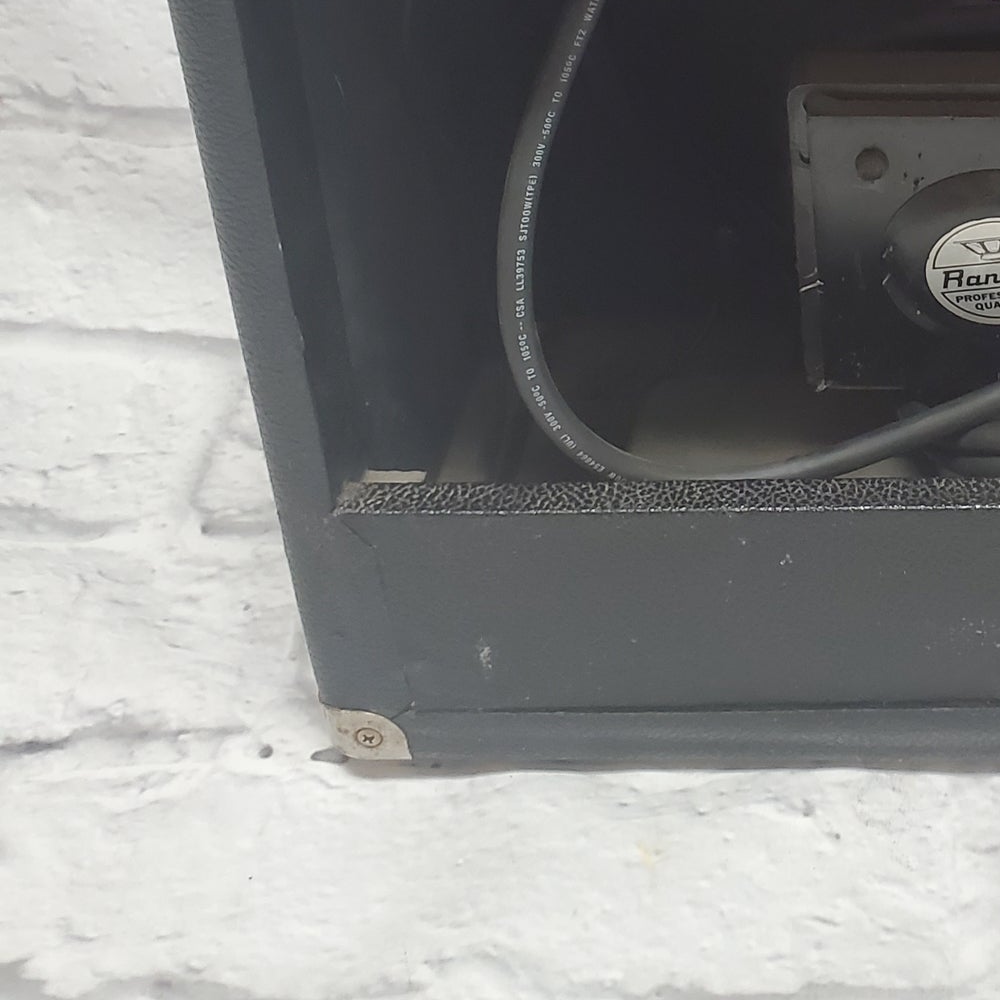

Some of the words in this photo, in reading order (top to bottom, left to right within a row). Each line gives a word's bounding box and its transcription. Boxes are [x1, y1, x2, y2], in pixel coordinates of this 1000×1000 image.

[551, 91, 563, 104] TO
[532, 143, 546, 167] 300V
[515, 249, 526, 291] LL39753
[515, 297, 525, 318] CSA
[526, 368, 537, 381] TO
[543, 411, 561, 432] 300V
